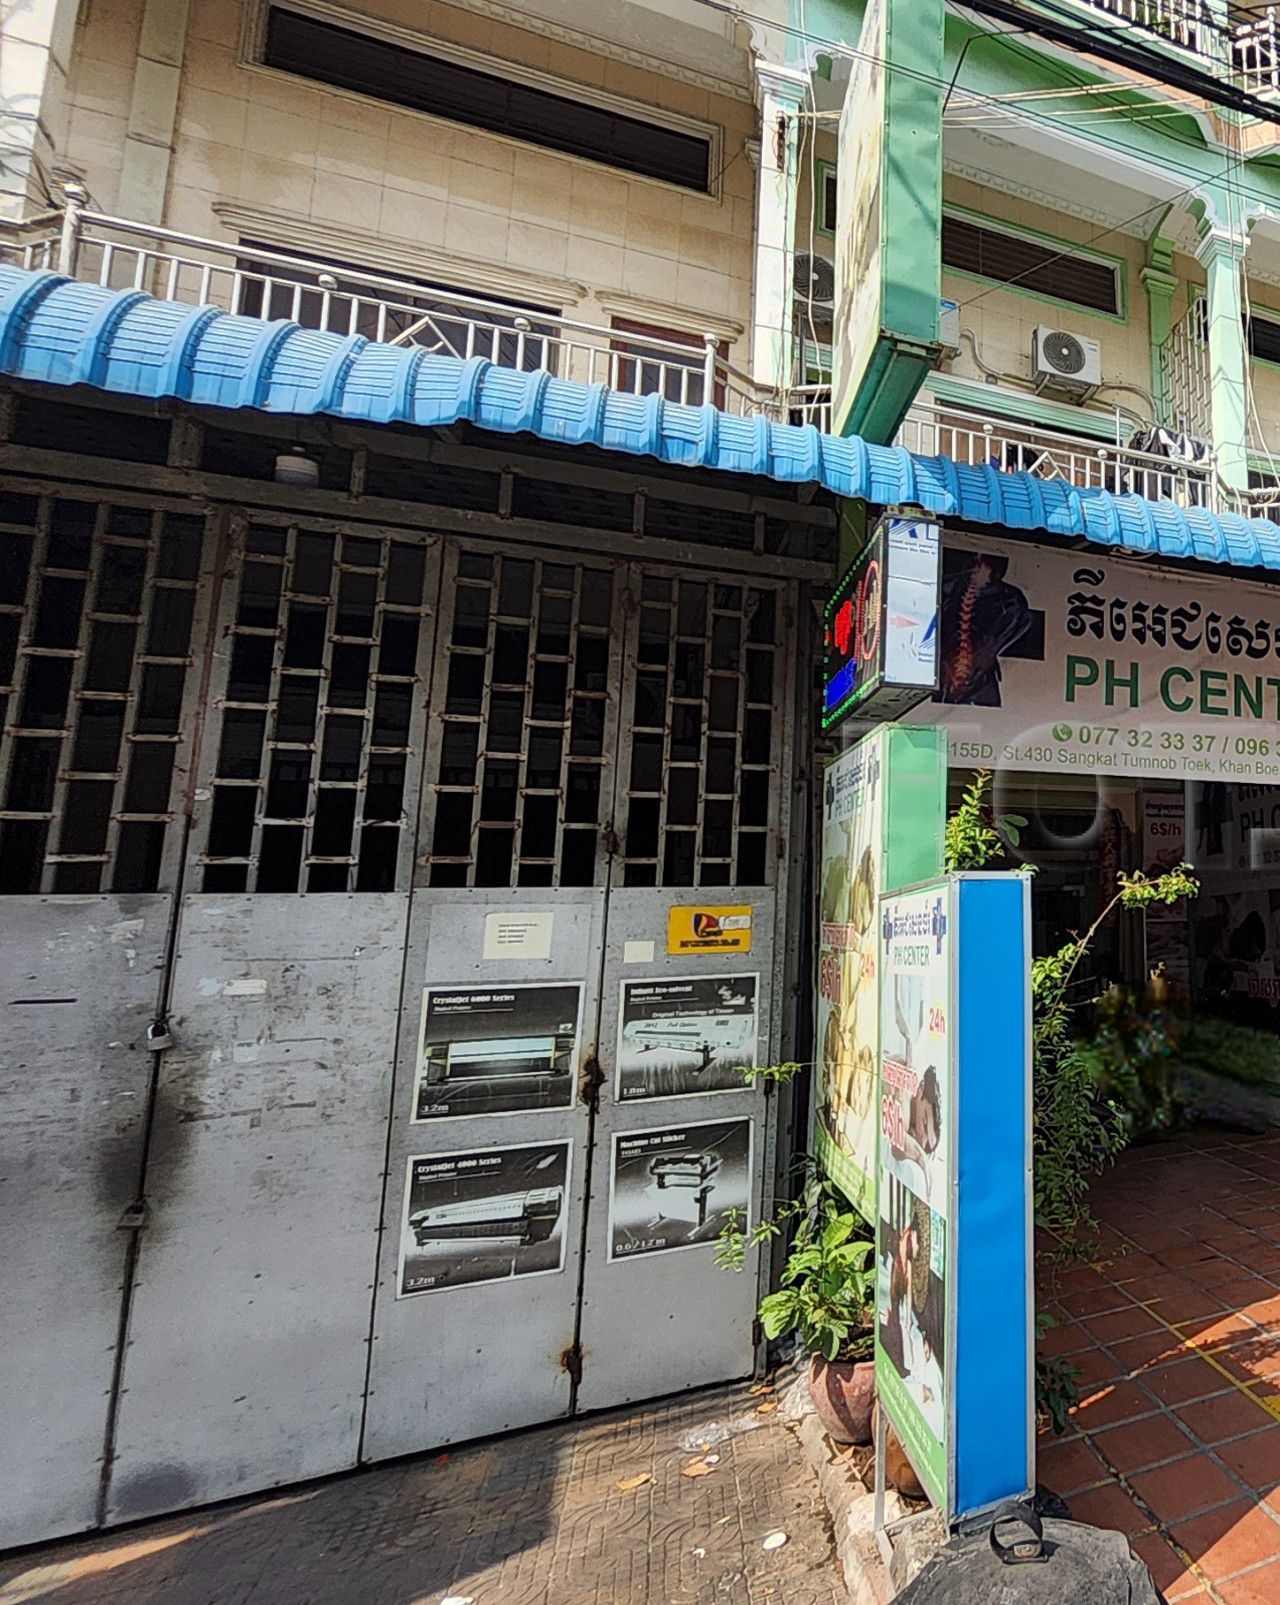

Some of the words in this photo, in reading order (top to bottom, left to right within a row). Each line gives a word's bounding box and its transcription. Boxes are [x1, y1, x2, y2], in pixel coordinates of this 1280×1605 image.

[1065, 654, 1139, 708] PH
[1078, 726, 1119, 745] 077
[1127, 729, 1153, 748] 32
[1160, 732, 1185, 750] 33
[1191, 734, 1216, 752] 37
[1235, 738, 1269, 756] 096
[1002, 744, 1052, 762] St.430
[1058, 749, 1117, 768] Sangkat
[1122, 753, 1176, 769] Tumnob
[1181, 756, 1215, 773] Toek,
[1220, 759, 1250, 774] Khan
[1240, 807, 1264, 843] PH
[903, 945, 929, 967] CENTER
[491, 994, 515, 1002] Series
[929, 1008, 946, 1035] 24h
[478, 1157, 502, 1166] Series
